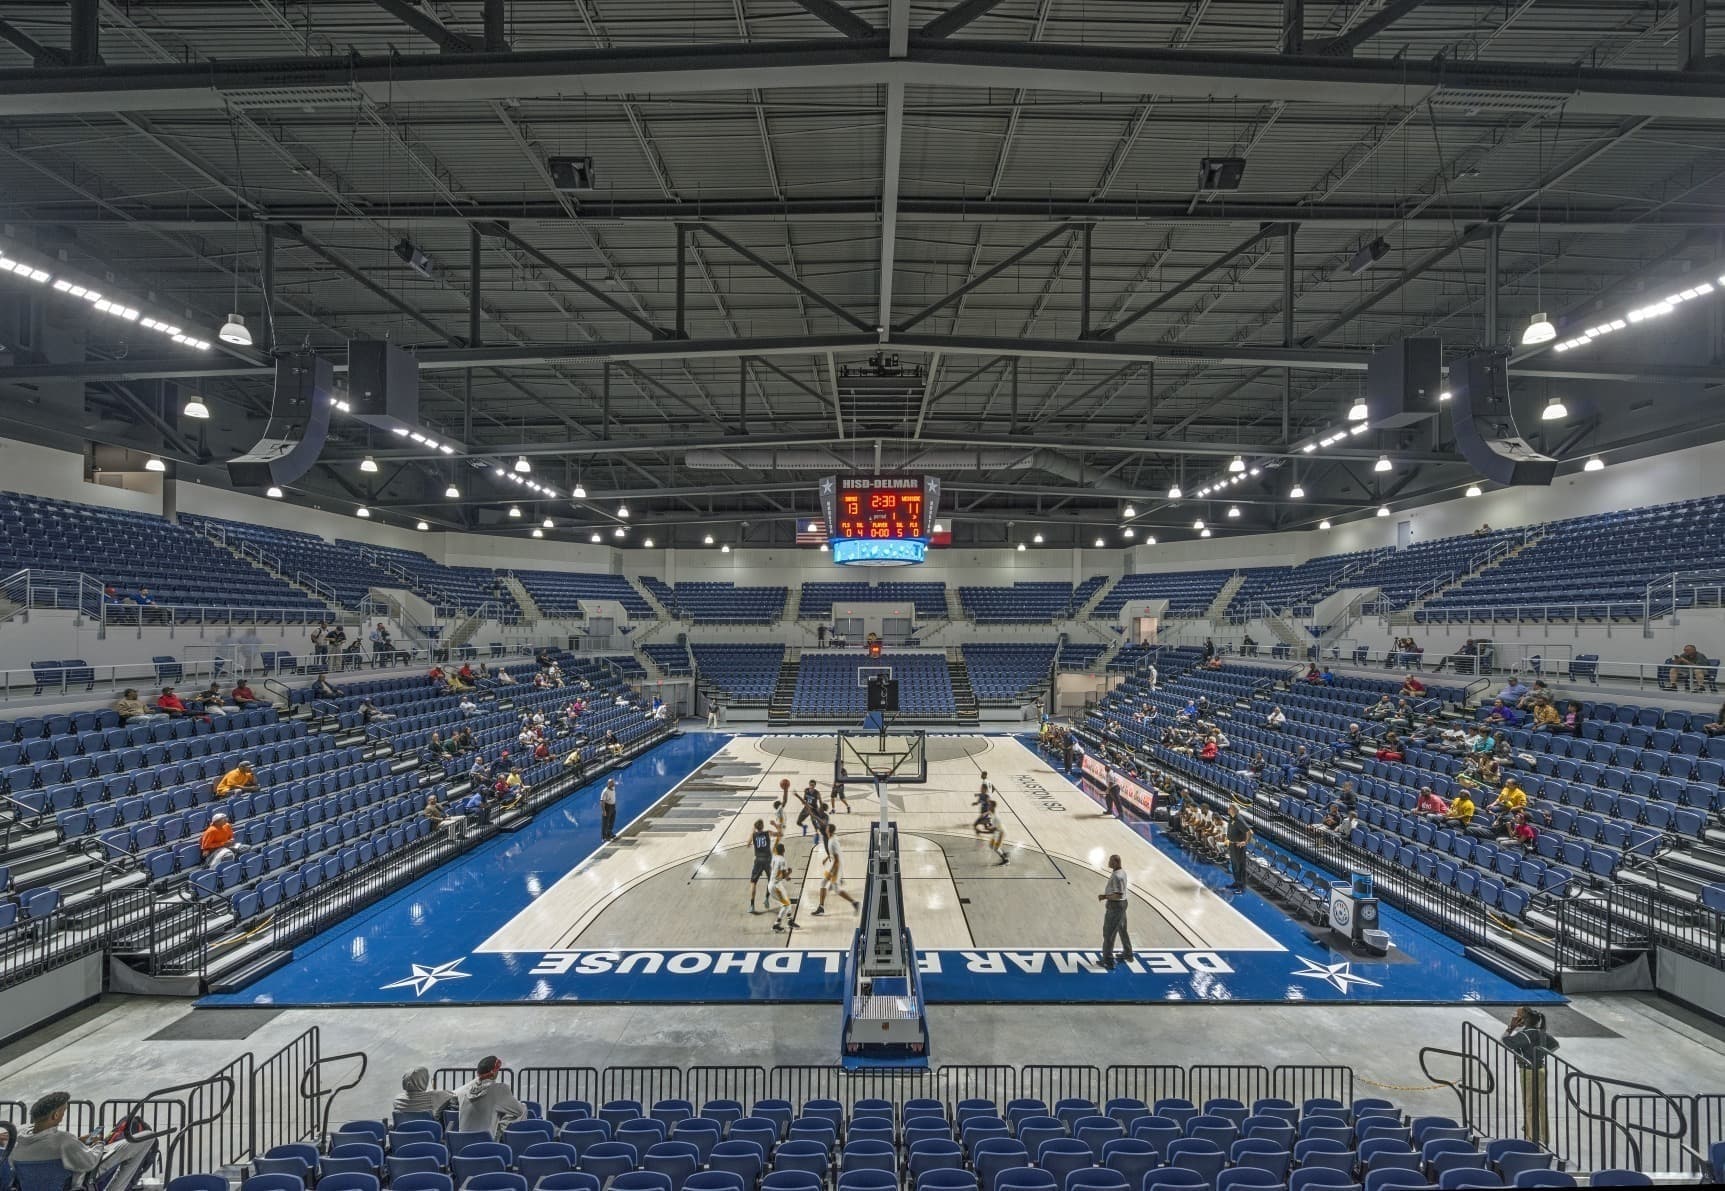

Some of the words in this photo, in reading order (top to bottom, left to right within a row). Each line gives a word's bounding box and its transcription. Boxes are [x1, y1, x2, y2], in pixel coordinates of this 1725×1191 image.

[842, 479, 919, 489] HISD-DELMAR
[848, 502, 858, 515] 13
[909, 502, 919, 514] 11
[1041, 800, 1067, 812] ISD
